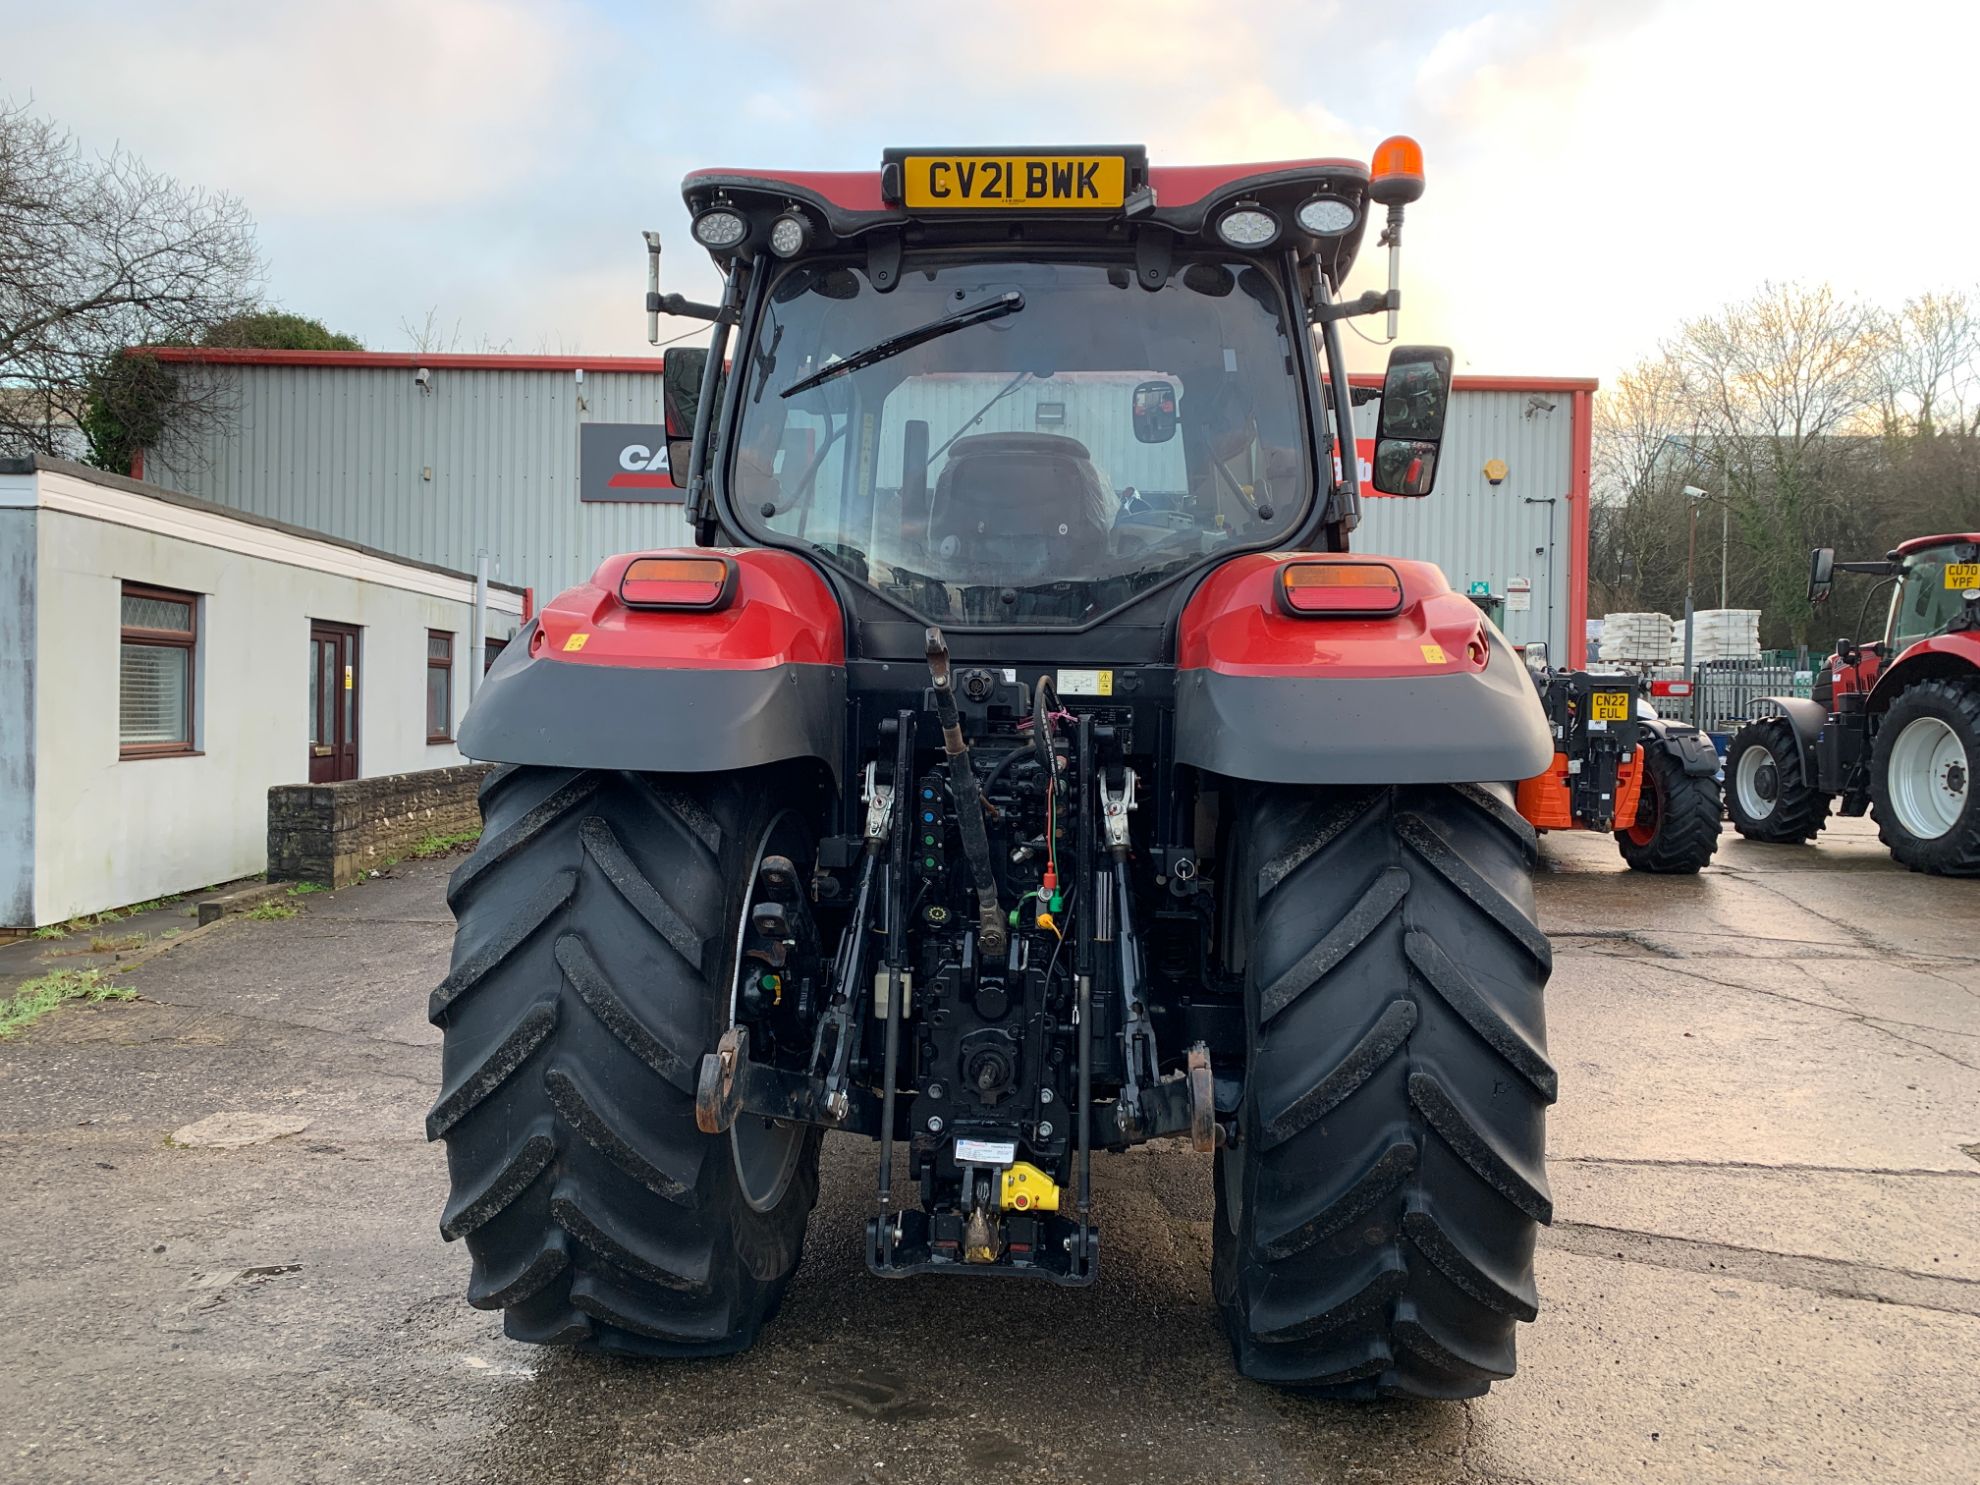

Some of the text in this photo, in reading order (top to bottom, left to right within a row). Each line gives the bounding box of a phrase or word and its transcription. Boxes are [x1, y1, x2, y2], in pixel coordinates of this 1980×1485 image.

[929, 161, 1100, 199] CV21 BWK
[1948, 565, 1978, 576] CU70
[1952, 577, 1974, 588] YPF
[1596, 695, 1626, 706] CN22
[1599, 708, 1621, 719] EUL
